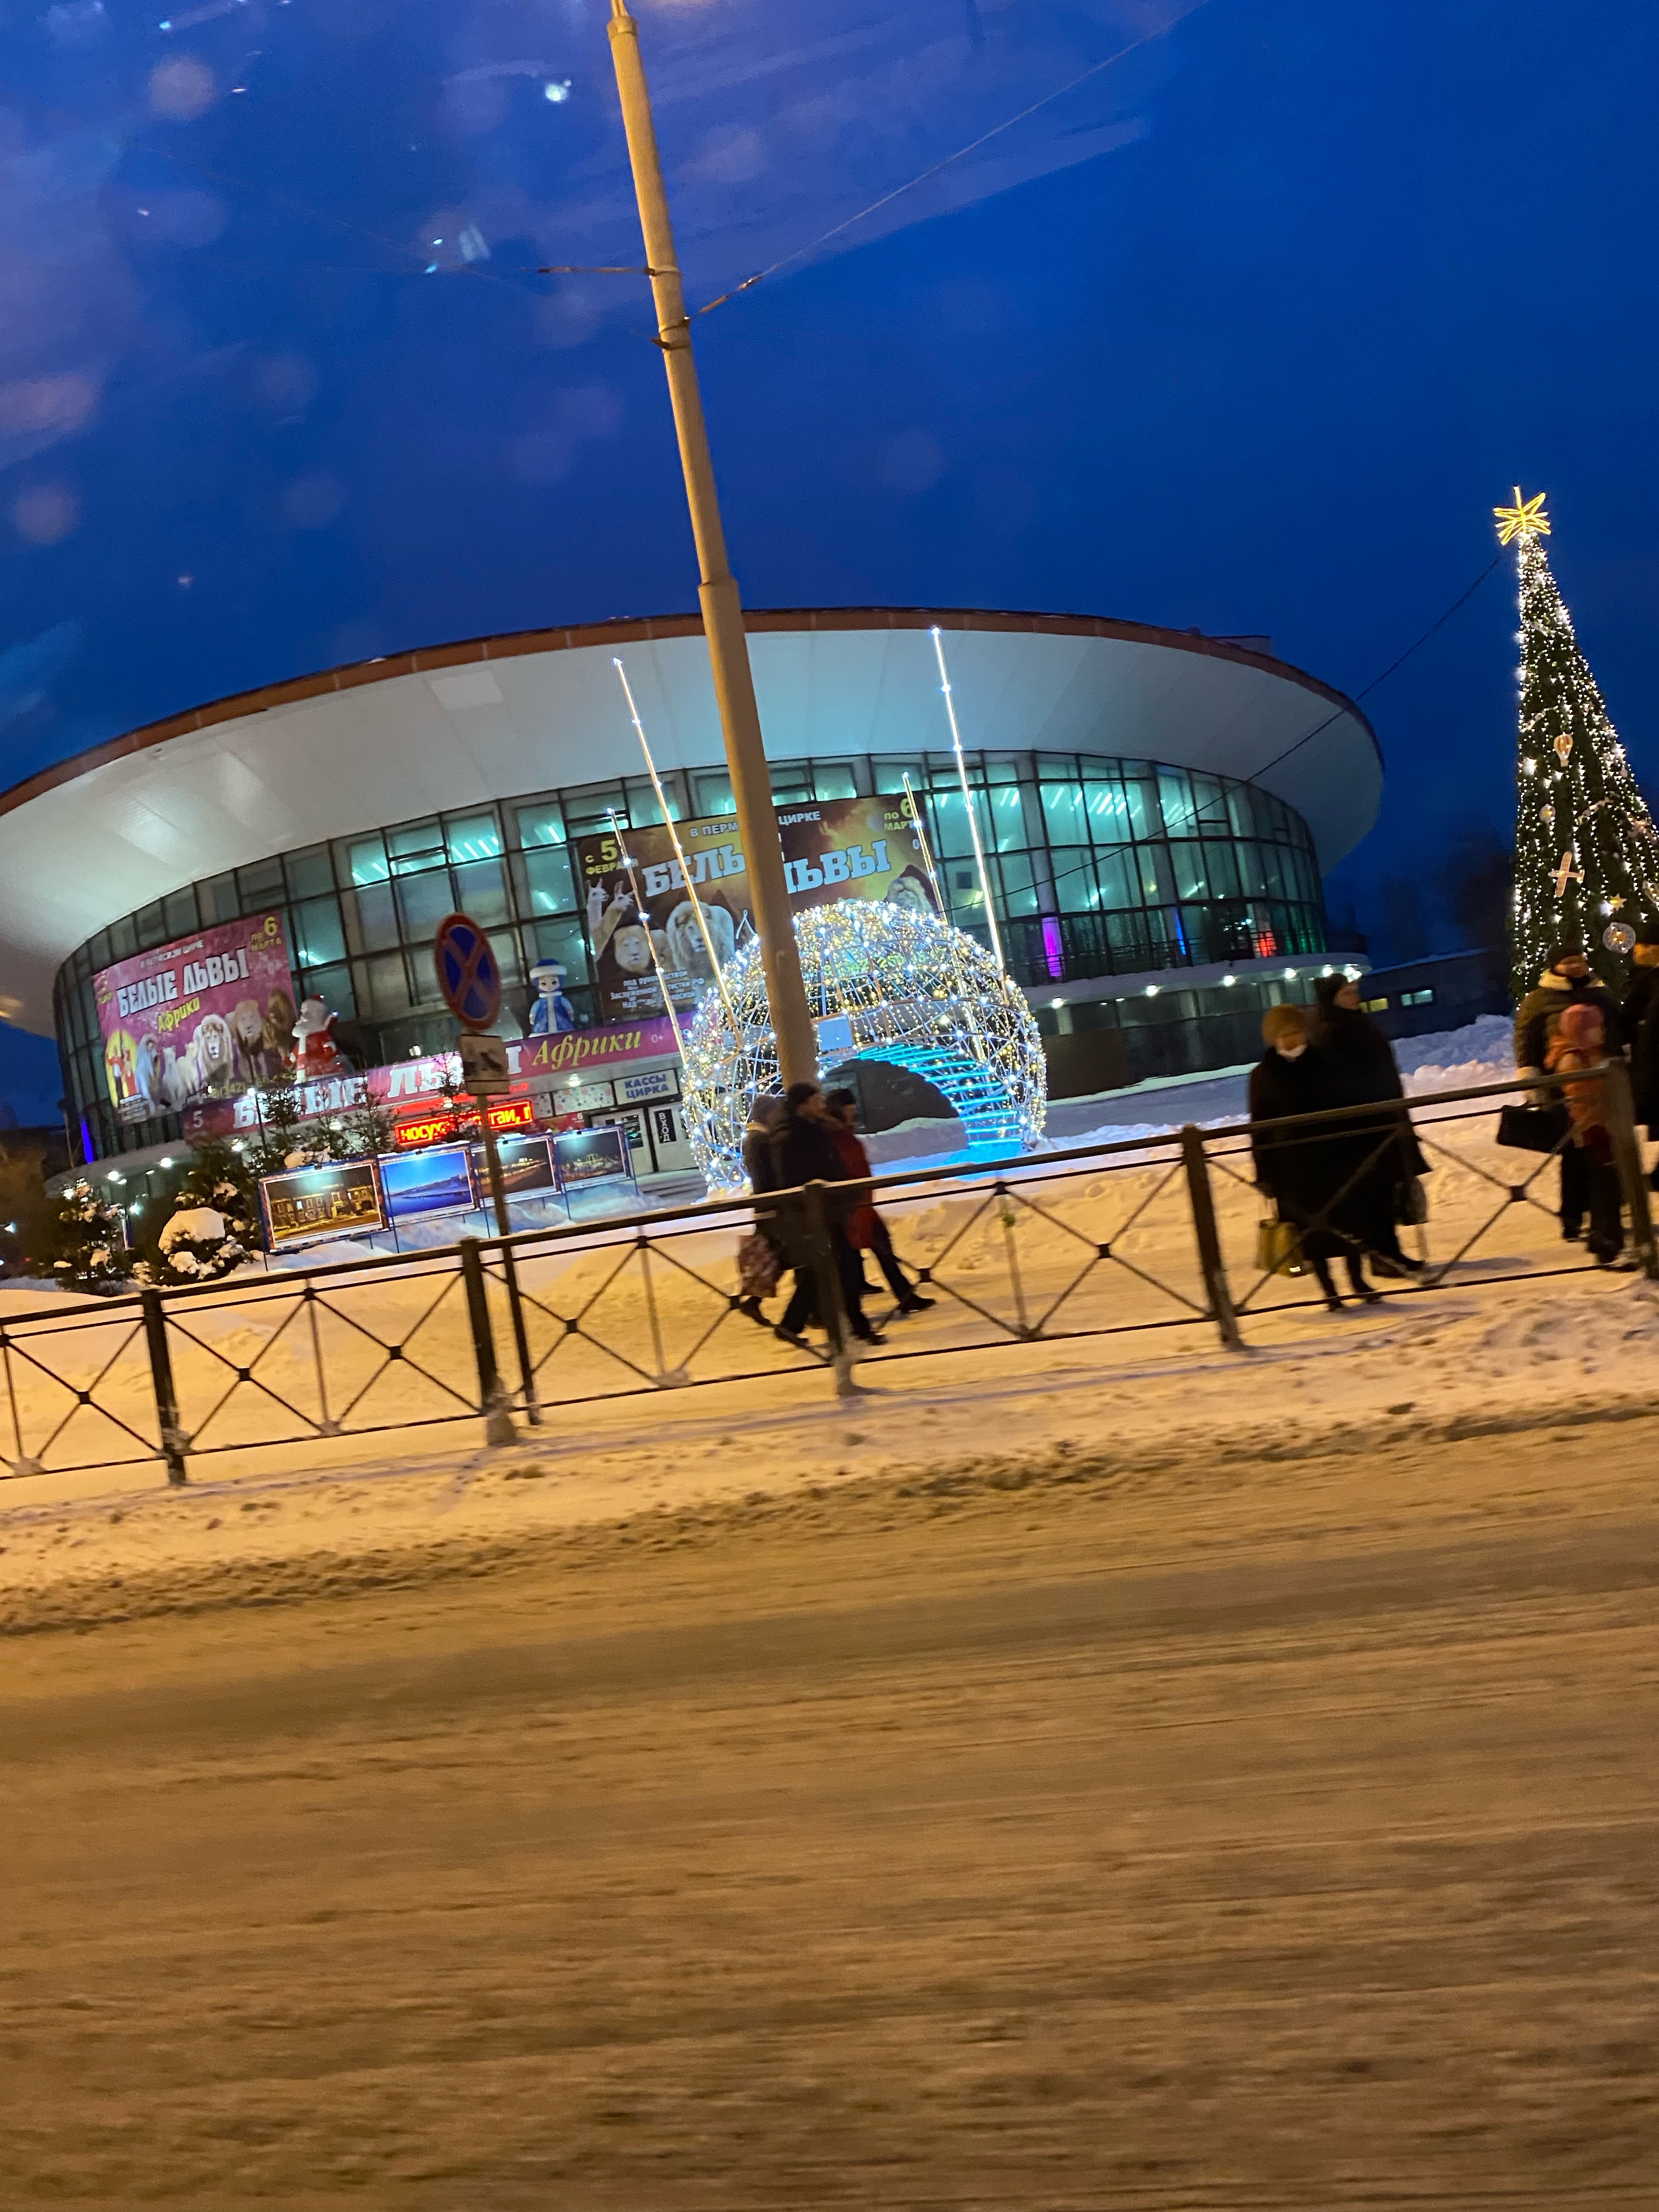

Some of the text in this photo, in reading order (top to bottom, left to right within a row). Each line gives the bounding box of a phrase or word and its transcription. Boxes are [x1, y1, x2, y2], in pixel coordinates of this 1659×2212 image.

[900, 798, 914, 819] 6
[690, 827, 698, 838] В
[778, 811, 821, 826] ЦИРКЕ
[883, 819, 917, 832] МАРТ
[600, 839, 618, 861] 5
[585, 857, 639, 876] ФЕВРАЯ
[264, 916, 278, 936] 6
[116, 969, 178, 1019] БЕЛЫЕ
[183, 945, 250, 996] ЛЬВЫ
[157, 996, 201, 1034] Африки
[193, 1110, 202, 1128] 5
[233, 1076, 368, 1129] БЕЫЕ
[532, 1030, 642, 1070] Африки
[651, 1034, 664, 1043] 0+
[624, 1073, 667, 1090] КАССЫ
[625, 1084, 669, 1099] ЦИРКА
[400, 1119, 447, 1141] носух
[658, 1111, 671, 1143] ВХОД
